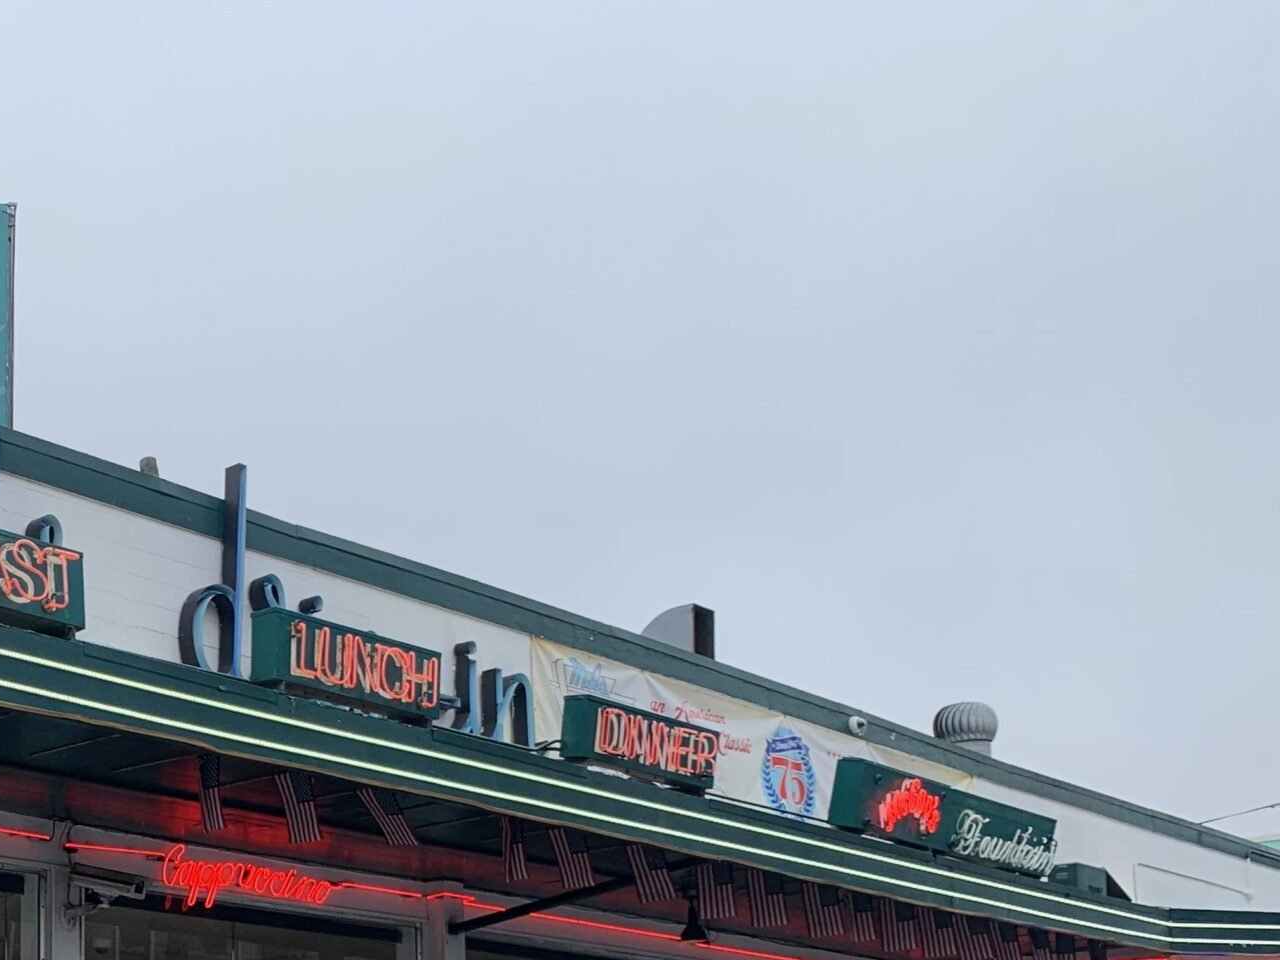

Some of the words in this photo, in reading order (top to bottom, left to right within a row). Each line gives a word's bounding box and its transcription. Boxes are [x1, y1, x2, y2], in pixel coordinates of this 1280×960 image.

[290, 620, 440, 708] LUNCH
[594, 706, 719, 777] DINNER
[770, 755, 807, 806] 75
[163, 843, 334, 909] Cappuccino
